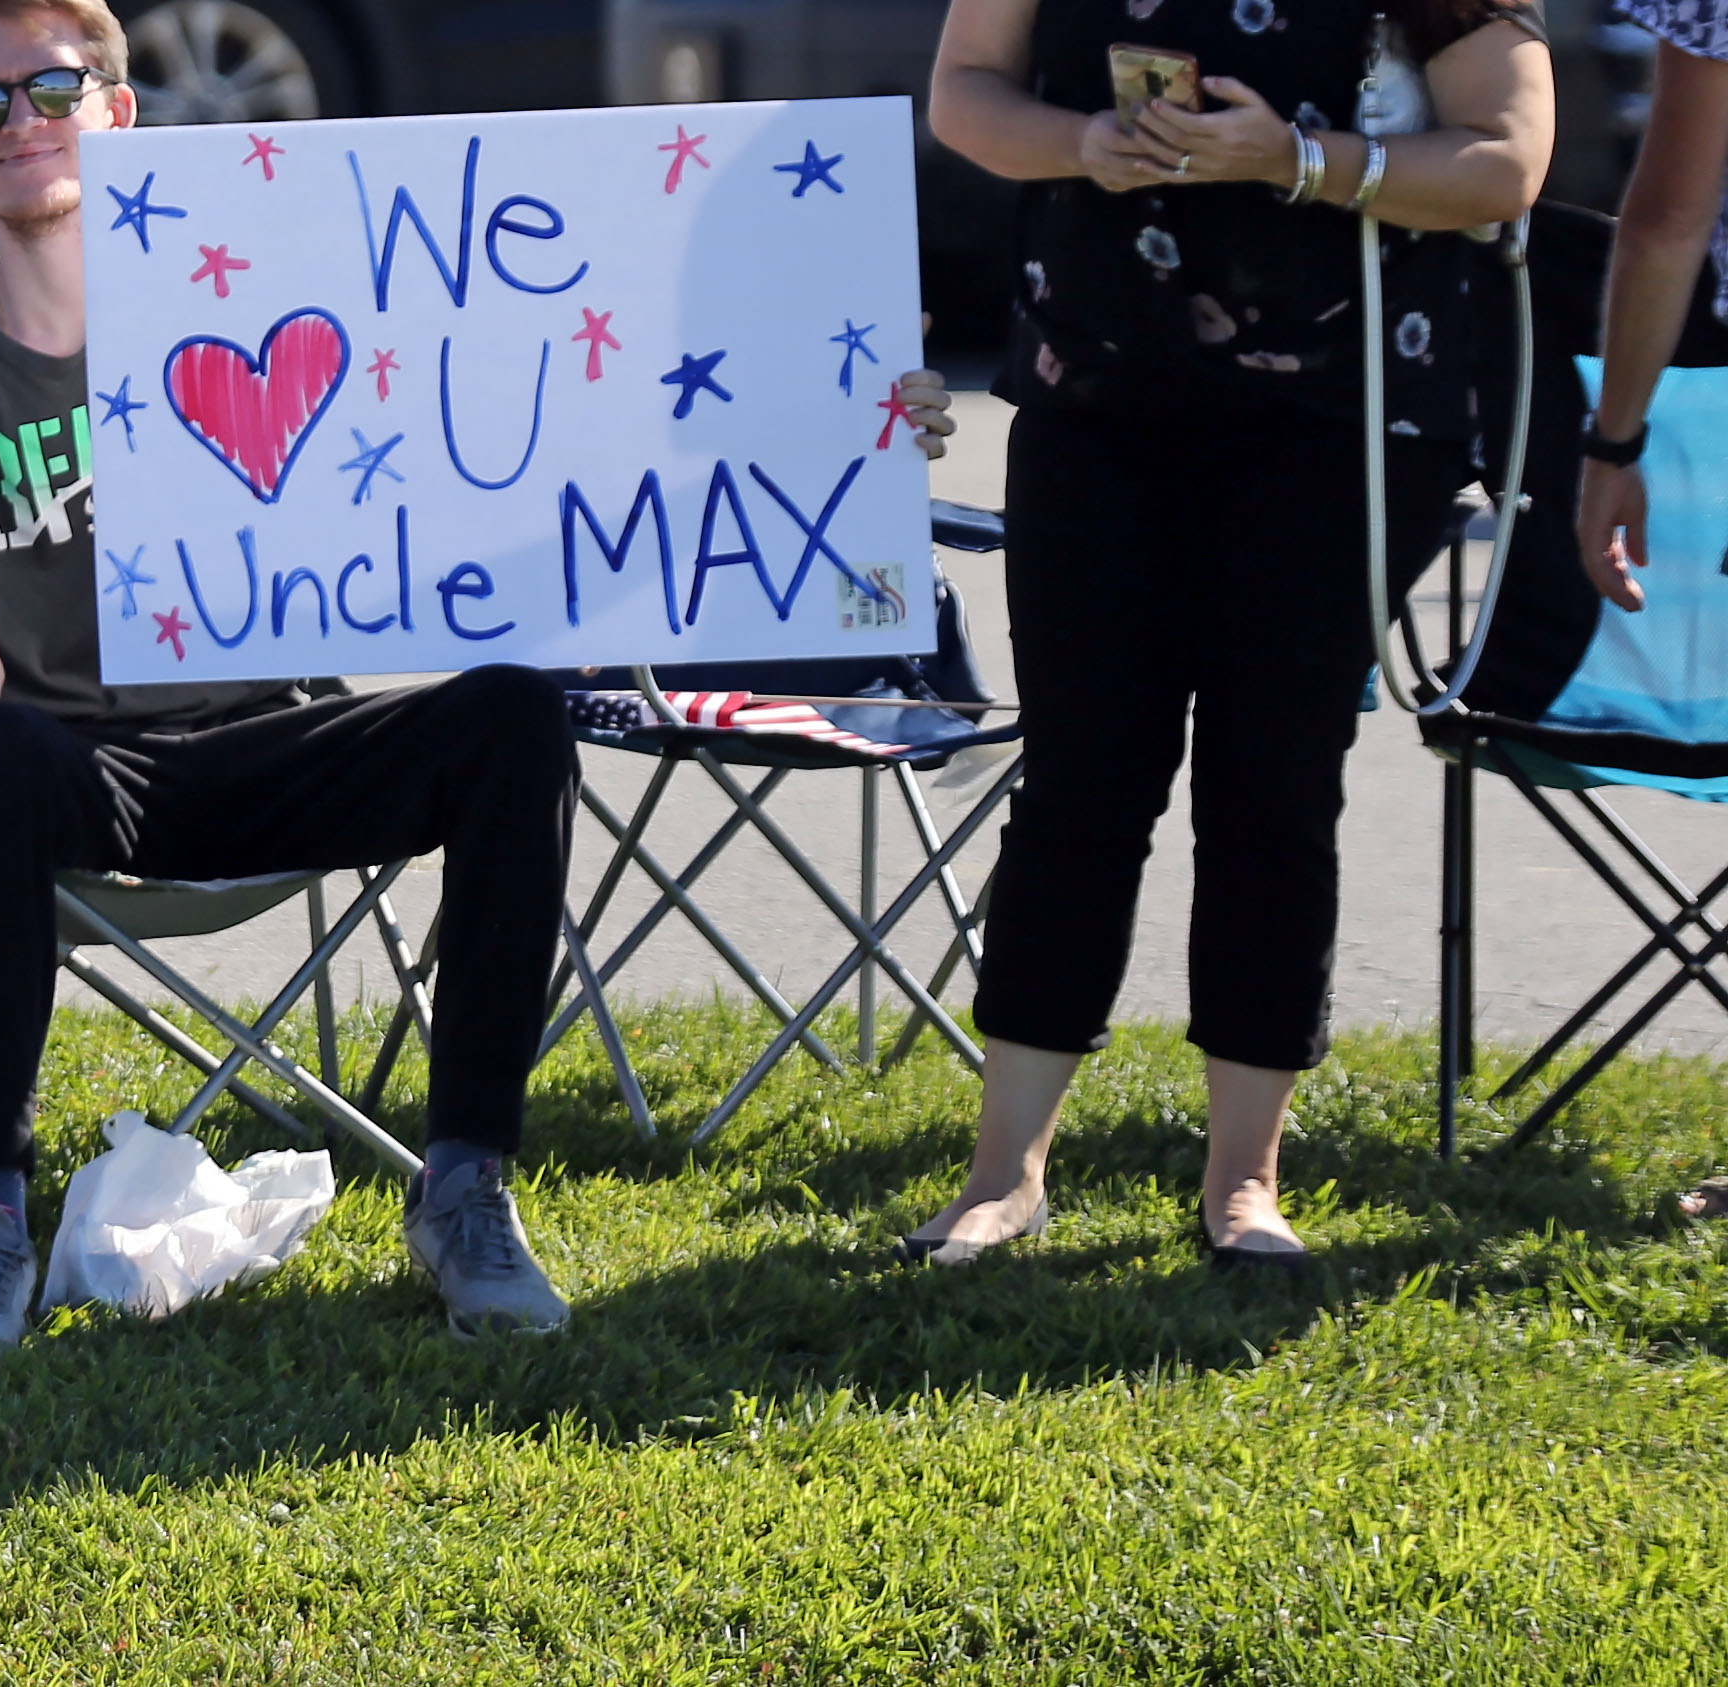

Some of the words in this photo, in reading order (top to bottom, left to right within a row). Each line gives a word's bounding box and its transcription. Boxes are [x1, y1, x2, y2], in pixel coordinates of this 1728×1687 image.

[346, 135, 589, 312] We
[440, 335, 551, 490] U
[176, 503, 515, 650] Uncle
[559, 455, 897, 634] MAX
